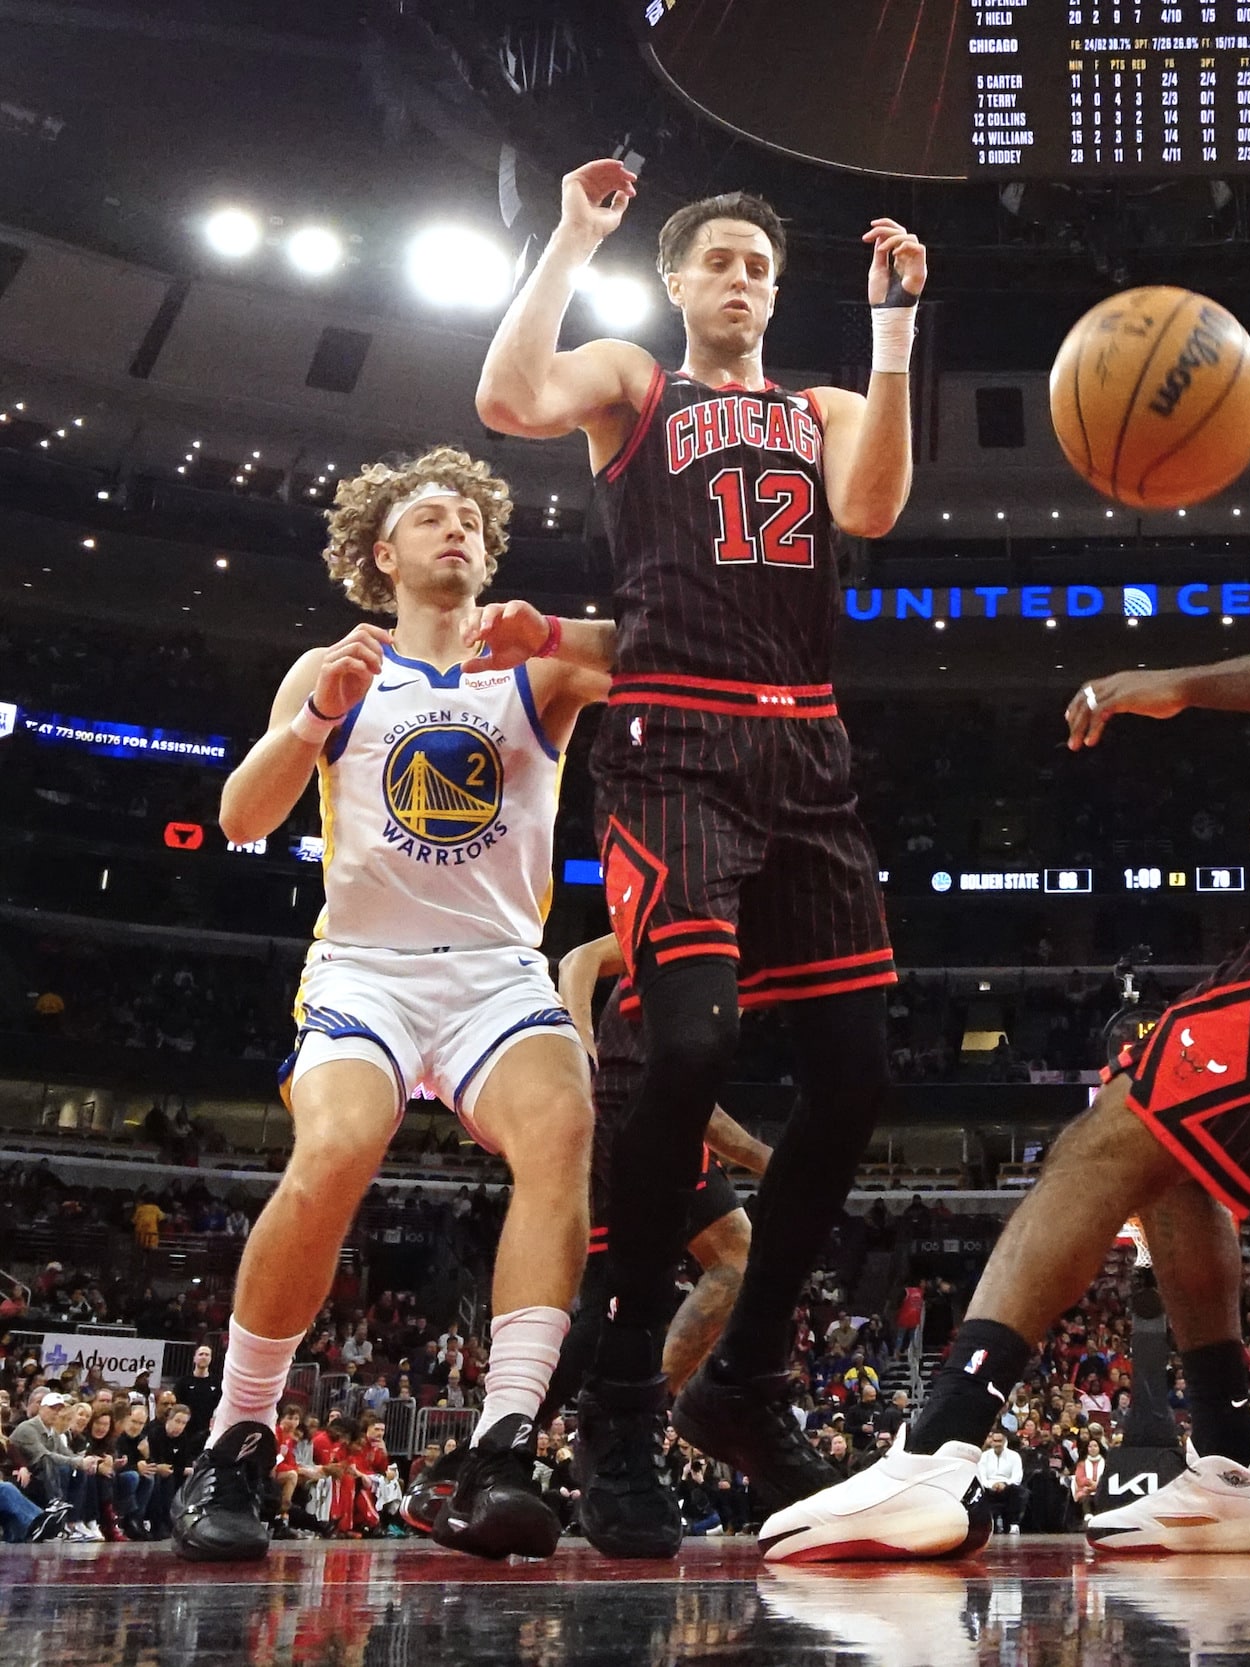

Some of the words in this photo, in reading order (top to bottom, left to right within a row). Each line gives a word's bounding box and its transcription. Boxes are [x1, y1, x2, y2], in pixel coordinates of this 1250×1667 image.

[976, 12, 982, 25] 7
[986, 12, 1012, 25] HIELD
[1069, 10, 1081, 24] 20
[1093, 10, 1099, 24] 2
[1114, 10, 1120, 23] 9
[1135, 10, 1140, 23] 7
[1161, 9, 1182, 23] 4/10
[1202, 8, 1215, 22] 1/5
[969, 39, 1018, 53] CHICAGO
[1215, 37, 1235, 50] 15/17
[1069, 60, 1083, 70] MIN
[1094, 60, 1099, 70] F
[1111, 60, 1125, 70] PTS
[1132, 59, 1146, 70] REB
[1165, 59, 1174, 68] FG
[1201, 58, 1215, 67] 3PT
[1241, 58, 1249, 66] FT
[977, 76, 984, 89] 5
[987, 75, 1022, 89] CARTER
[1072, 74, 1080, 88] 11
[1095, 74, 1099, 87] 1
[1115, 73, 1121, 87] 8
[1136, 73, 1140, 86] 1
[1162, 72, 1178, 87] 2/4
[1200, 72, 1216, 86] 2/4
[978, 94, 984, 108] 7
[987, 94, 1016, 107] TERRY
[1071, 93, 1082, 106] 14
[1094, 93, 1100, 106] 0
[1115, 92, 1121, 106] 4
[1136, 92, 1142, 106] 3
[1162, 91, 1178, 105] 2/3
[1200, 90, 1214, 105] 0/1
[974, 113, 984, 126] 12
[988, 112, 1026, 126] COLLINS
[1071, 112, 1082, 125] 13
[1095, 111, 1100, 125] 0
[1115, 111, 1121, 124] 3
[1136, 111, 1142, 124] 2
[1164, 110, 1178, 124] 1/4
[1201, 109, 1214, 123] 0/1
[1239, 109, 1250, 123] 1/1
[972, 132, 984, 145] 44
[988, 131, 1033, 145] WILLIAMS
[1072, 130, 1082, 144] 15
[1094, 130, 1101, 144] 2
[1116, 130, 1121, 143] 3
[1136, 130, 1142, 143] 5
[1164, 129, 1178, 143] 1/4
[1203, 128, 1214, 142] 1/1
[979, 151, 985, 164] 3
[988, 150, 1021, 164] GIDDEY
[1071, 149, 1083, 162] 28
[1096, 149, 1100, 162] 1
[1114, 149, 1123, 162] 11
[1137, 149, 1141, 162] 1
[1162, 148, 1181, 162] 4/11
[1203, 147, 1216, 161] 1/4
[666, 396, 826, 475] CHICAG
[709, 468, 814, 568] 12
[846, 585, 1104, 621] UNITED
[465, 675, 511, 690] Rakuten
[384, 710, 452, 745] GOLDEN
[461, 712, 508, 747] STATE
[56, 727, 74, 738] 773
[75, 730, 94, 741] 900
[95, 733, 120, 745] 6176
[123, 736, 147, 748] FOR
[151, 740, 225, 757] ASSISTANCE
[466, 752, 486, 787] 2
[382, 820, 509, 867] WARRIORS
[960, 874, 1003, 889] GOLDEN
[1004, 873, 1039, 889] STATE
[75, 1349, 156, 1373] Advocate
